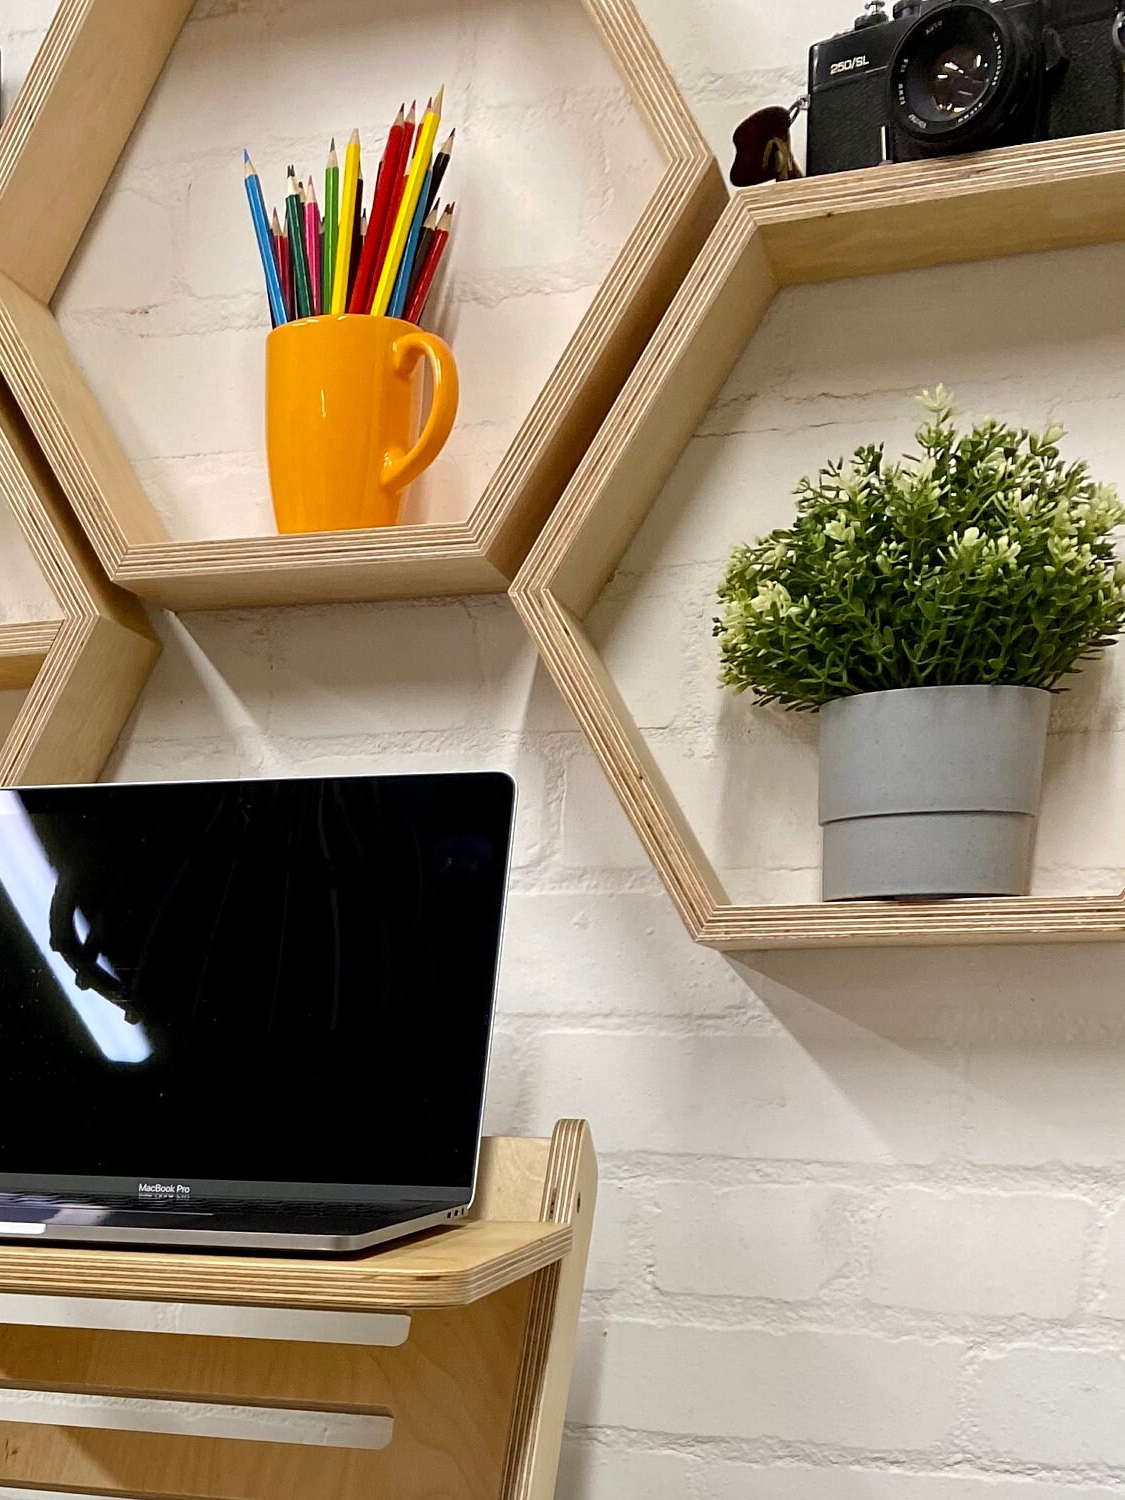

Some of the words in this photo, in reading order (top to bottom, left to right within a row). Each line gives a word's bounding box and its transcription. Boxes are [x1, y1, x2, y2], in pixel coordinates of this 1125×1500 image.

[830, 55, 870, 75] 250/SL
[138, 1183, 175, 1193] MacBook
[176, 1184, 191, 1194] Pro
